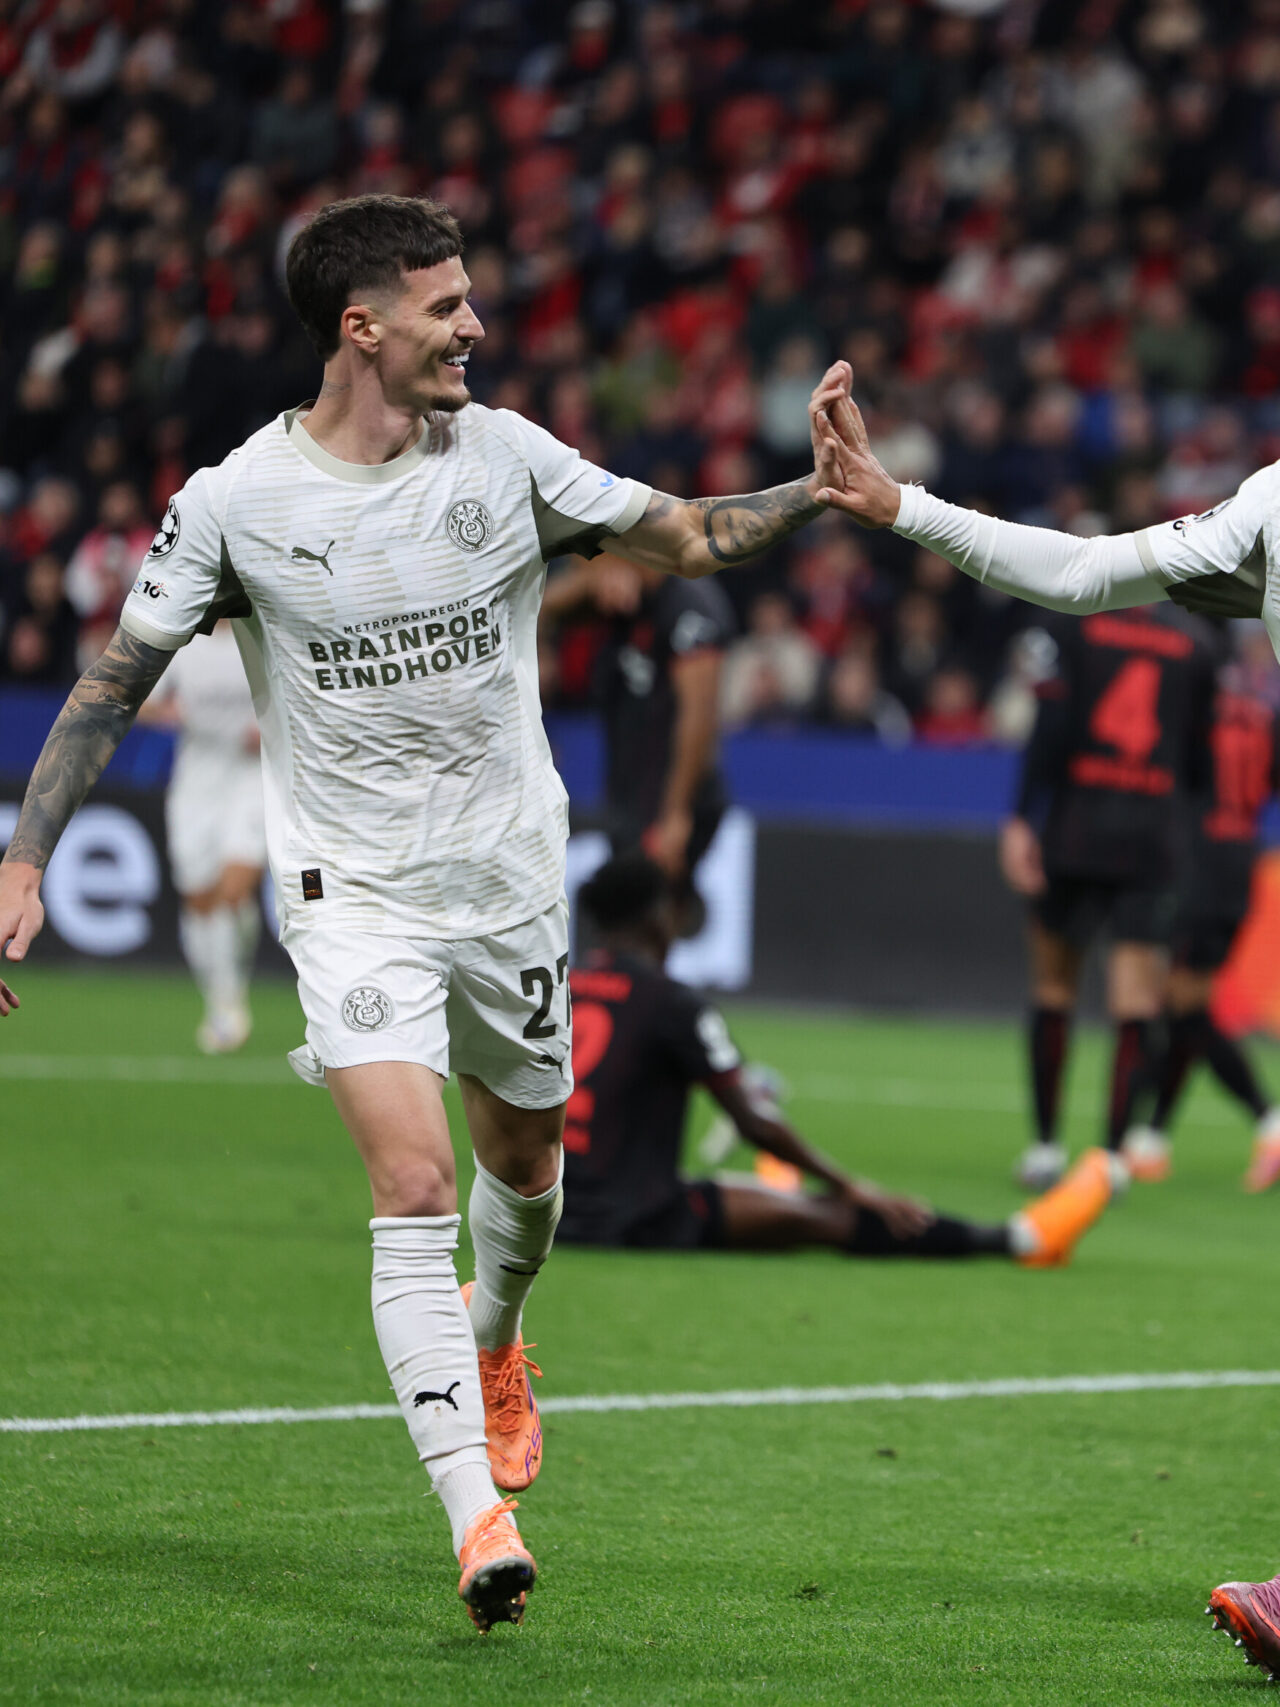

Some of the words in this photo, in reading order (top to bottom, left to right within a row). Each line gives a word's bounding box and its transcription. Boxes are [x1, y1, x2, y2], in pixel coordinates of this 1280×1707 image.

[308, 597, 498, 663] BRAINPORT
[343, 599, 470, 634] METROPOOLREGIO
[315, 622, 500, 691] EINDHOVEN
